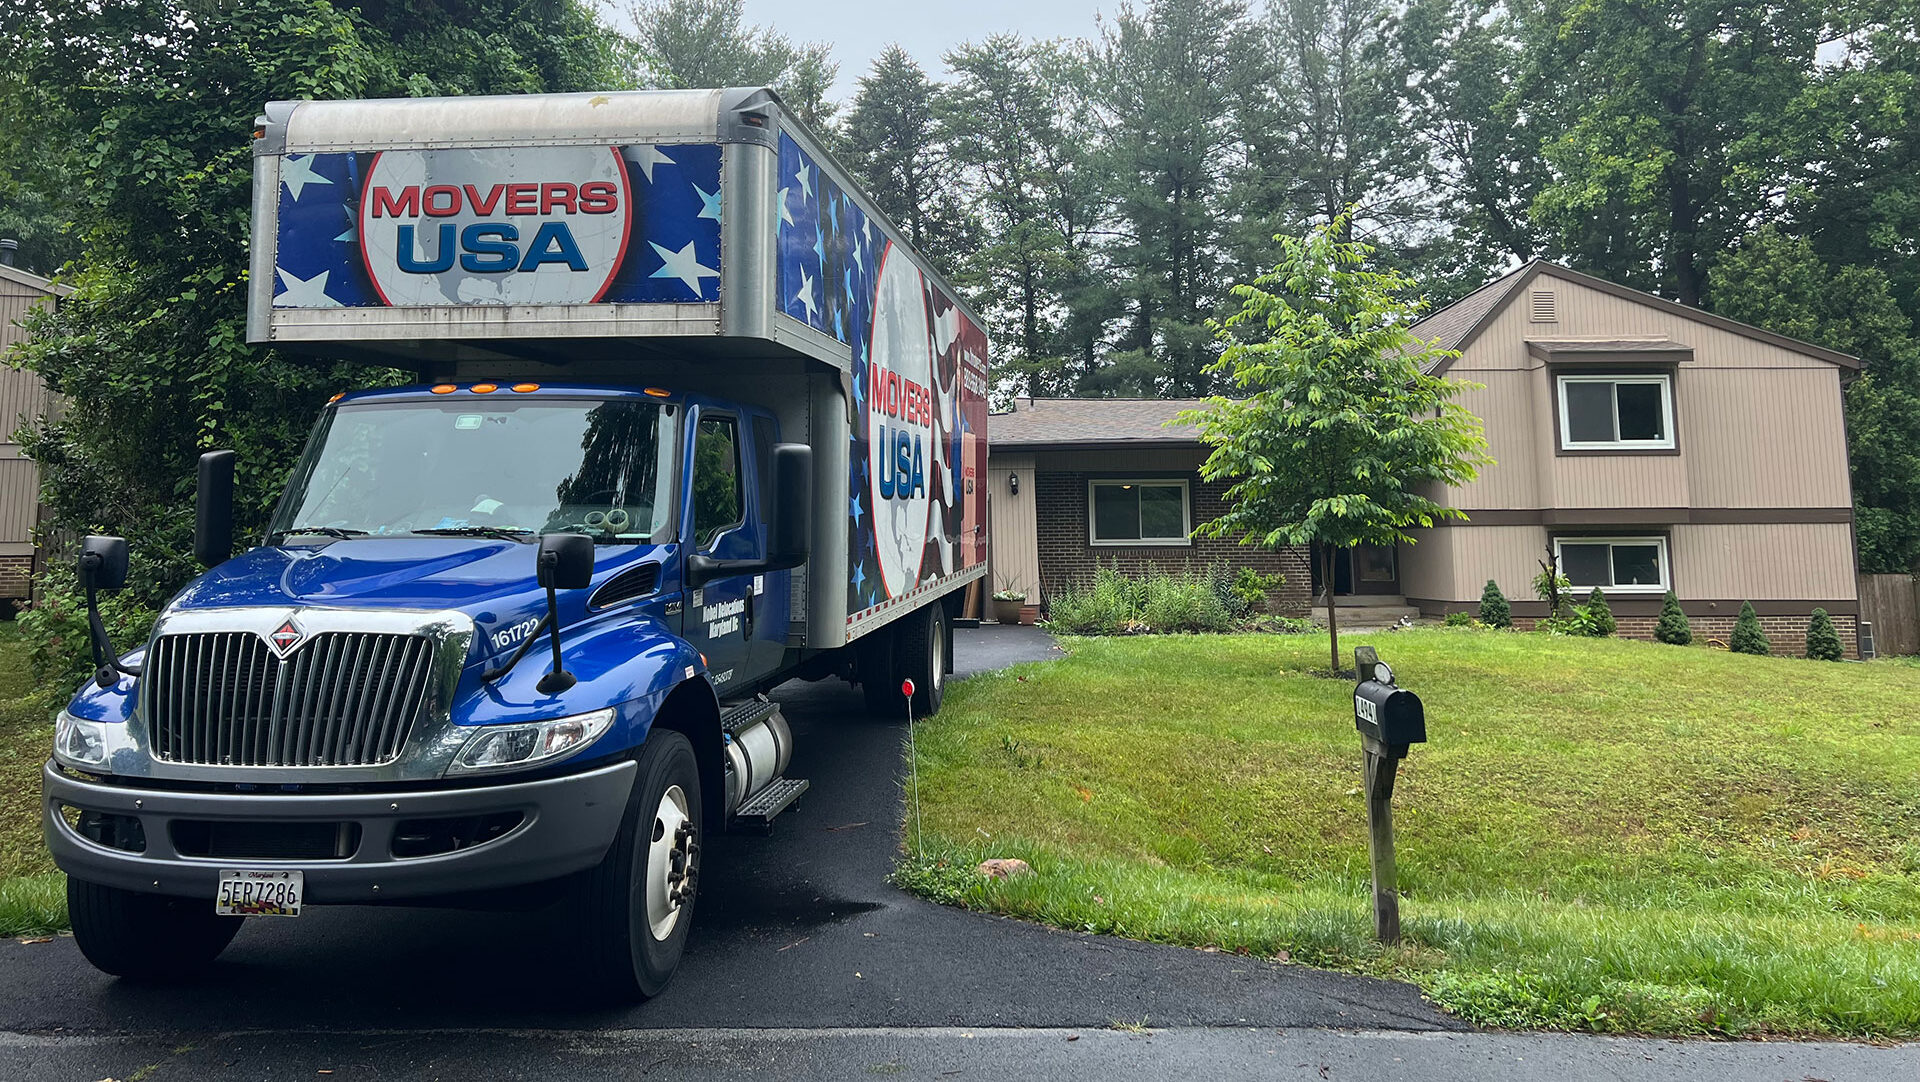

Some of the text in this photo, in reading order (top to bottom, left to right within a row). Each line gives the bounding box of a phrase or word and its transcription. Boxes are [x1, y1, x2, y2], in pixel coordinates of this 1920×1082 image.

[372, 181, 618, 218] MOVERS
[396, 221, 589, 274] USA
[872, 362, 930, 429] MOVERS
[879, 424, 925, 500] USA
[491, 618, 538, 649] 161722
[221, 881, 296, 906] 5ER7286
[248, 871, 274, 880] Maryland
